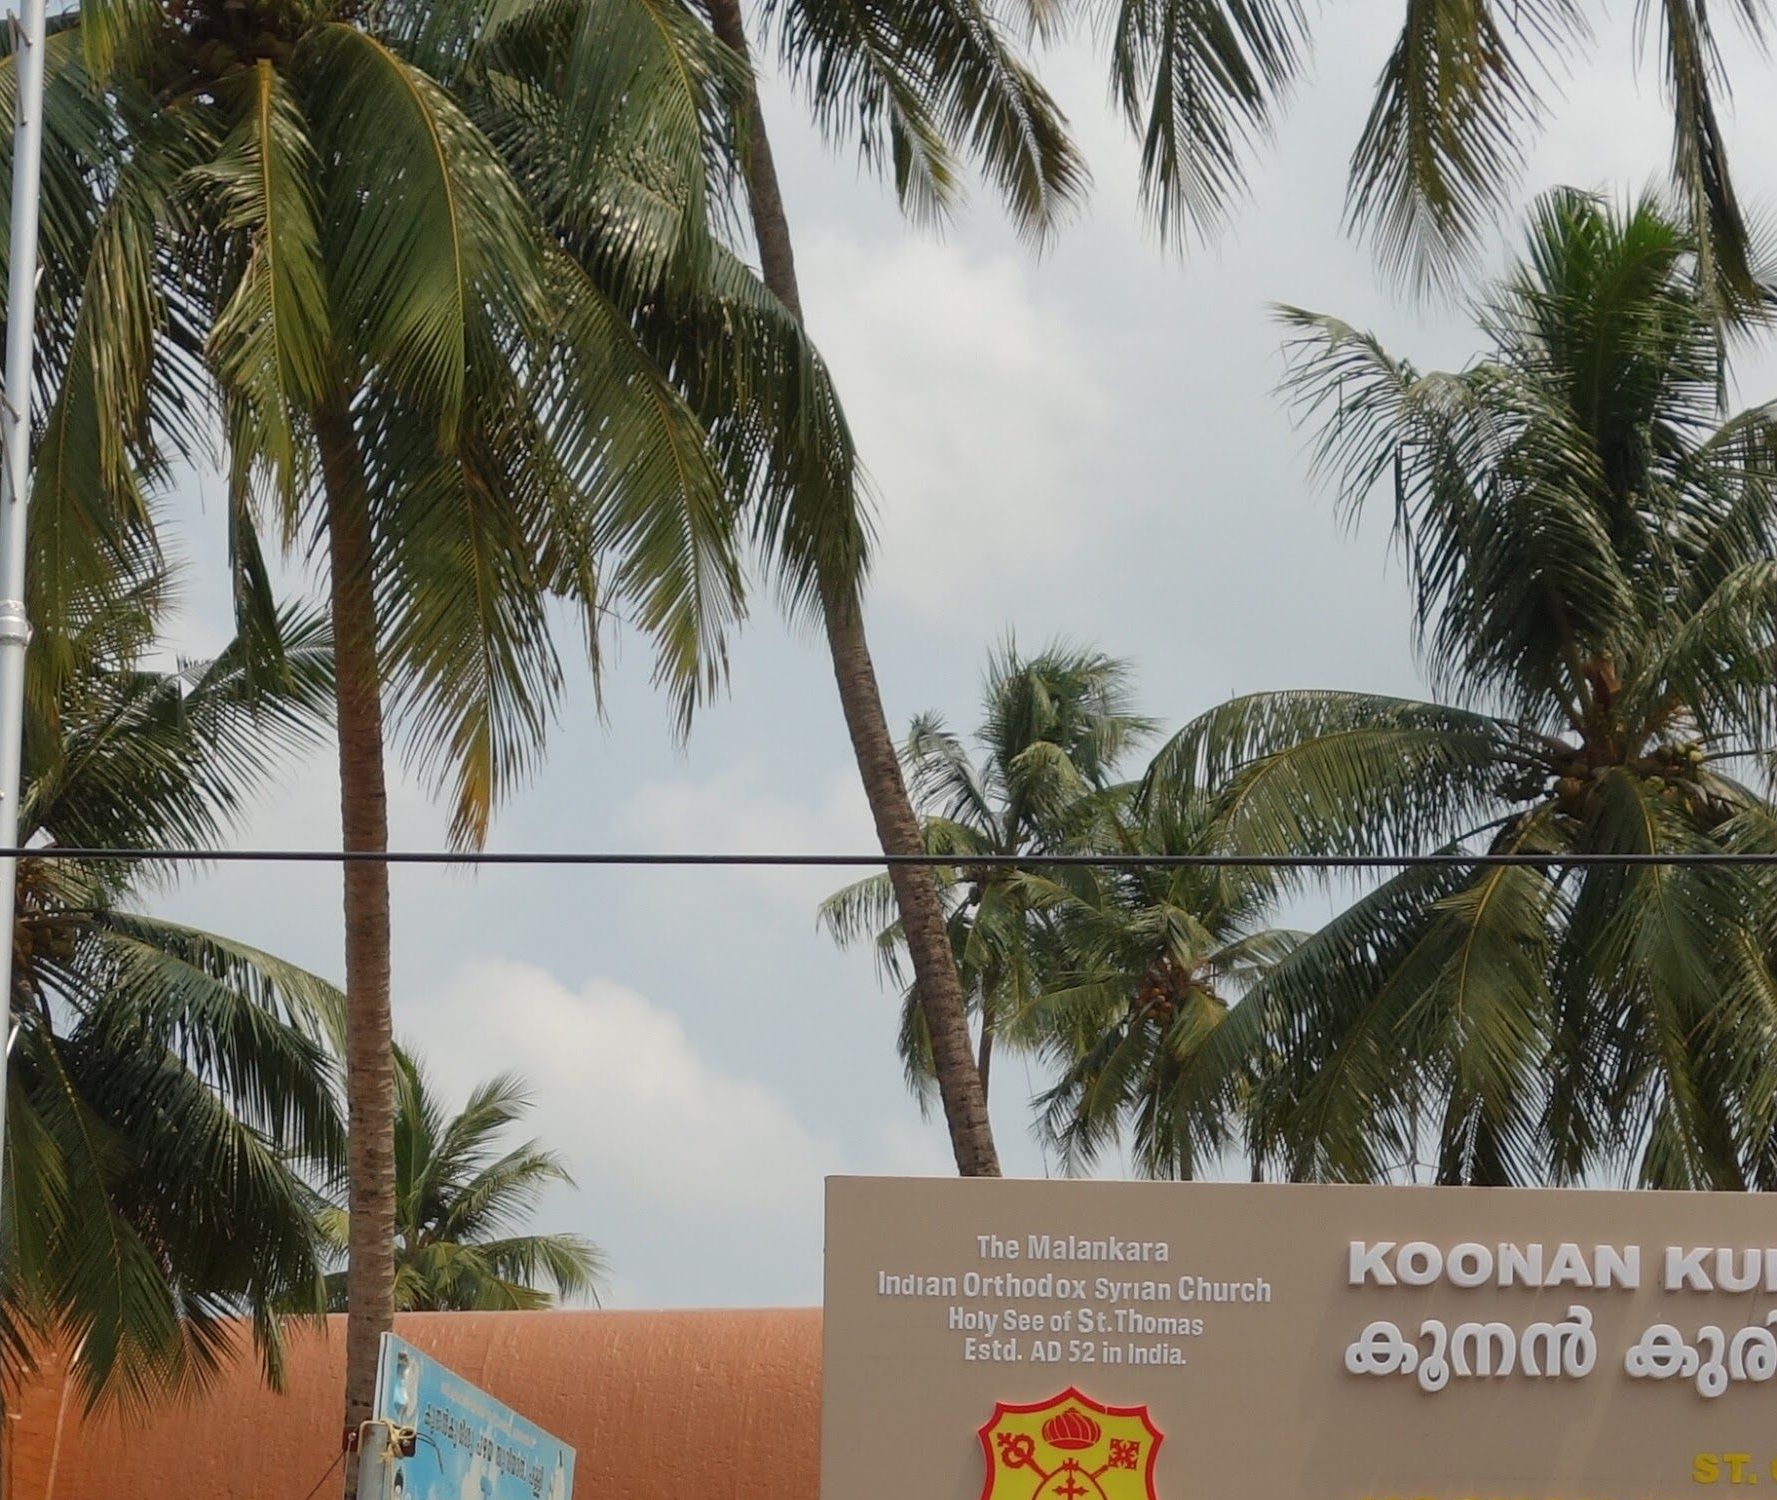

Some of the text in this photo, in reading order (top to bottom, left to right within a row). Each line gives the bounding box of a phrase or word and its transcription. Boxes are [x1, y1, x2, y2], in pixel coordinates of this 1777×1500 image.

[977, 1234, 1169, 1262] The Malankara
[1348, 1239, 1641, 1289] KOONAN
[878, 1270, 1272, 1304] Indian Orthodox Syrian Church
[948, 1306, 999, 1337] Holy
[1003, 1309, 1044, 1331] See
[1050, 1310, 1071, 1332] of
[964, 1338, 1187, 1366] Estd. AD 52 in India.
[1344, 1305, 1597, 1393] കൂനൻ
[1692, 1453, 1758, 1485] ST.
